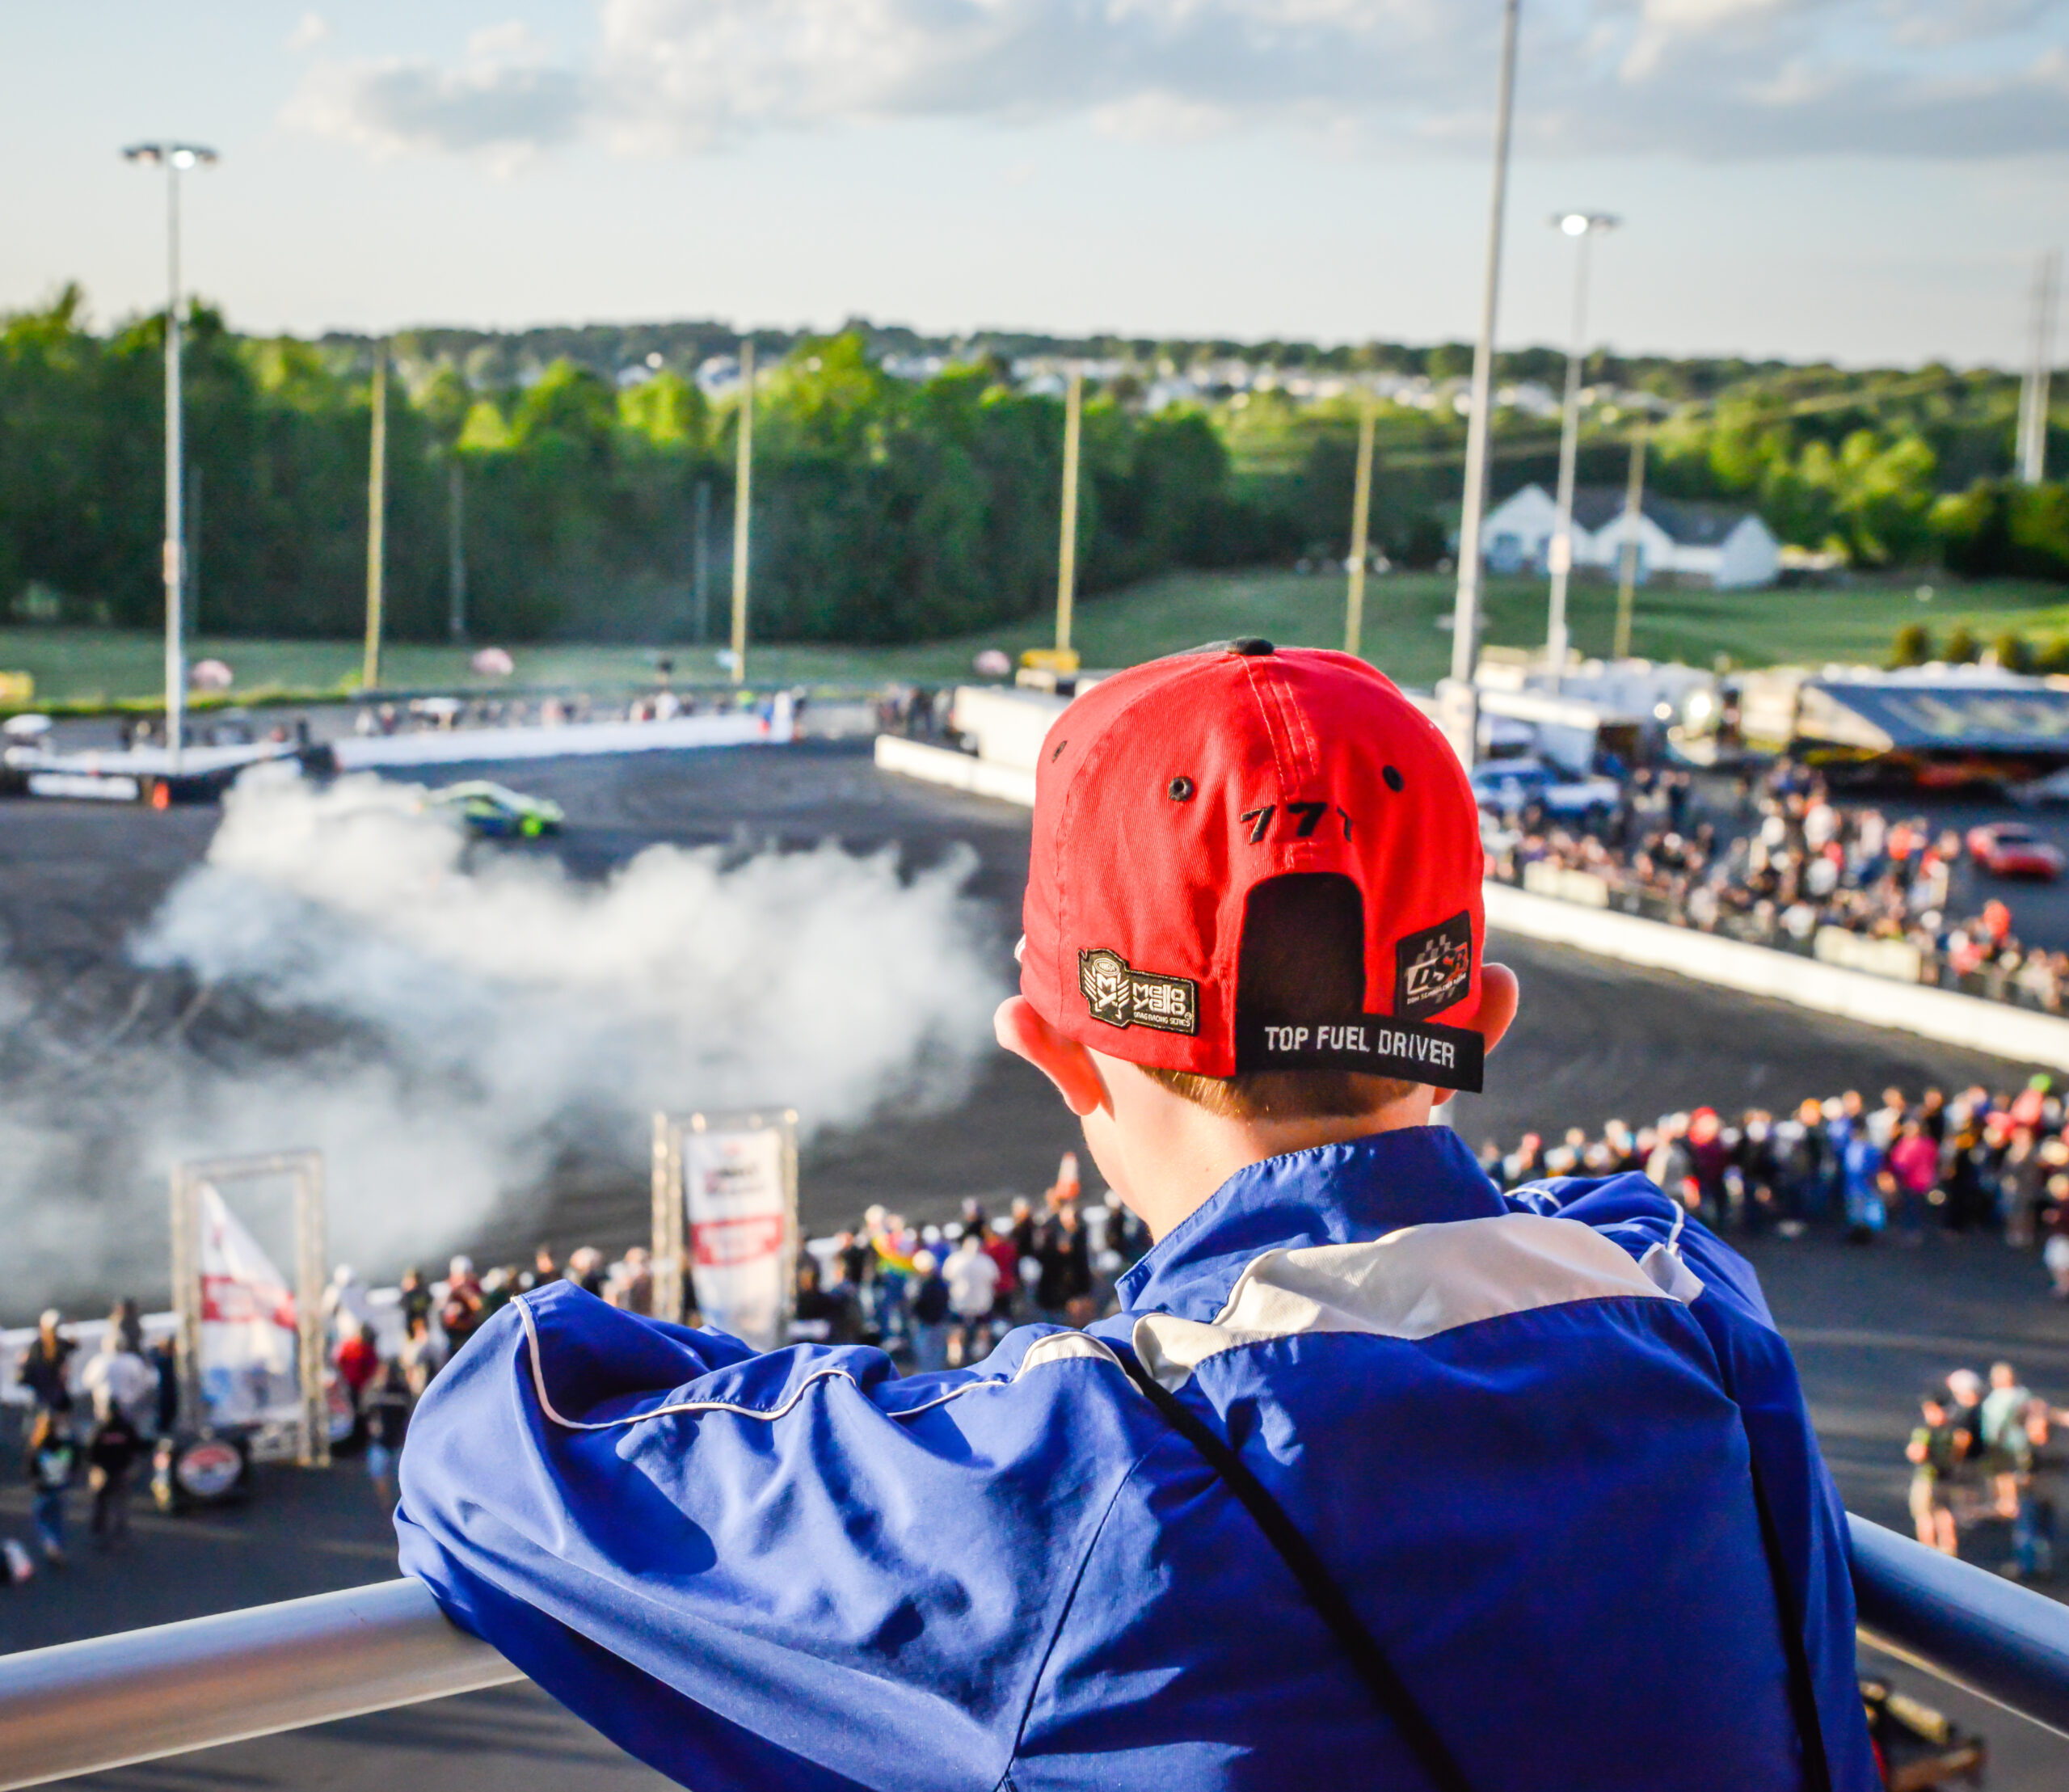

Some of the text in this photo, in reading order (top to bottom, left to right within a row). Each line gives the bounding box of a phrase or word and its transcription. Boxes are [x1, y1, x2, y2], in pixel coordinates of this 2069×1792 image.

[1264, 1025, 1456, 1069] TOP FUEL DRIVER
